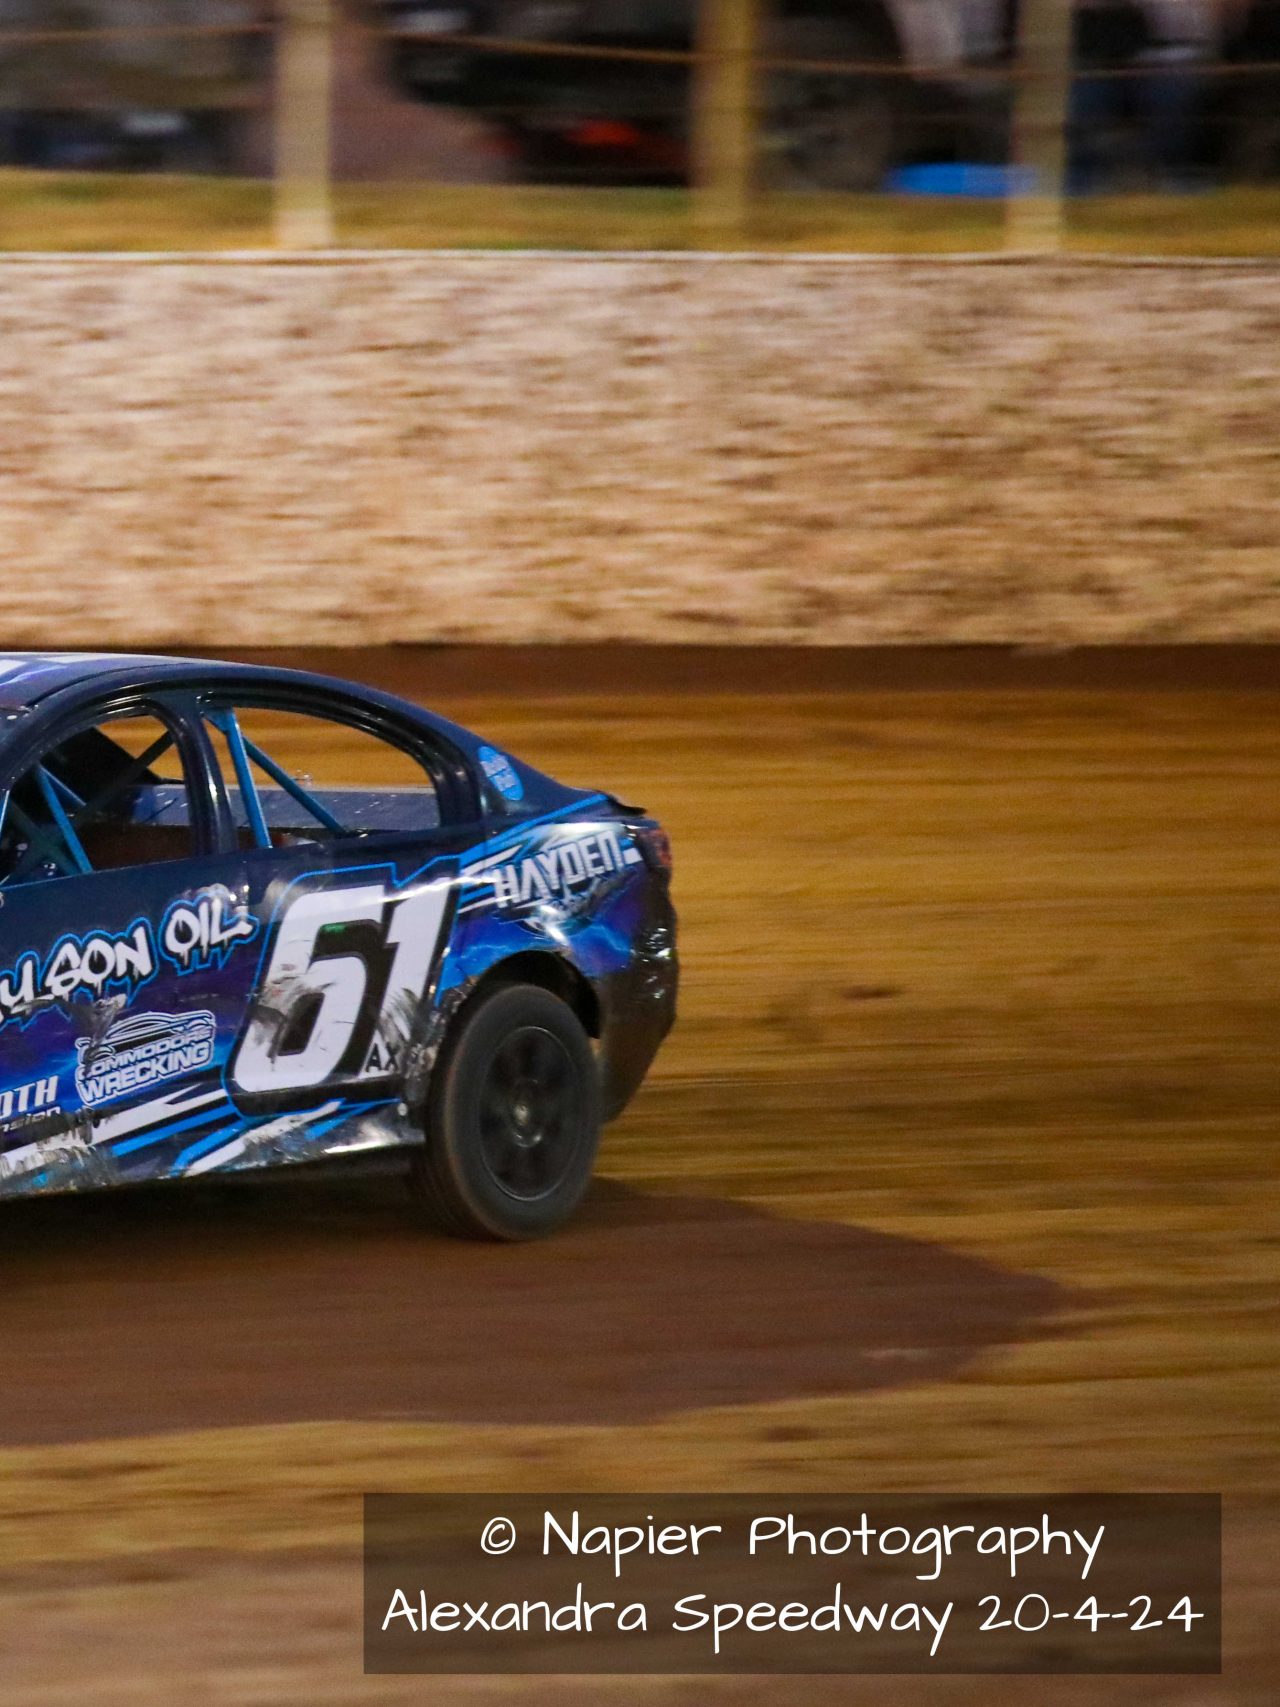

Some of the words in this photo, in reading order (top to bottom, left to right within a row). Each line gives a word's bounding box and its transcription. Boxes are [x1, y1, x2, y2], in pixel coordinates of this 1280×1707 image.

[493, 829, 625, 910] HAYDEN
[164, 896, 254, 967] OIL
[233, 876, 453, 1094] 61
[79, 1041, 210, 1103] WRECKING
